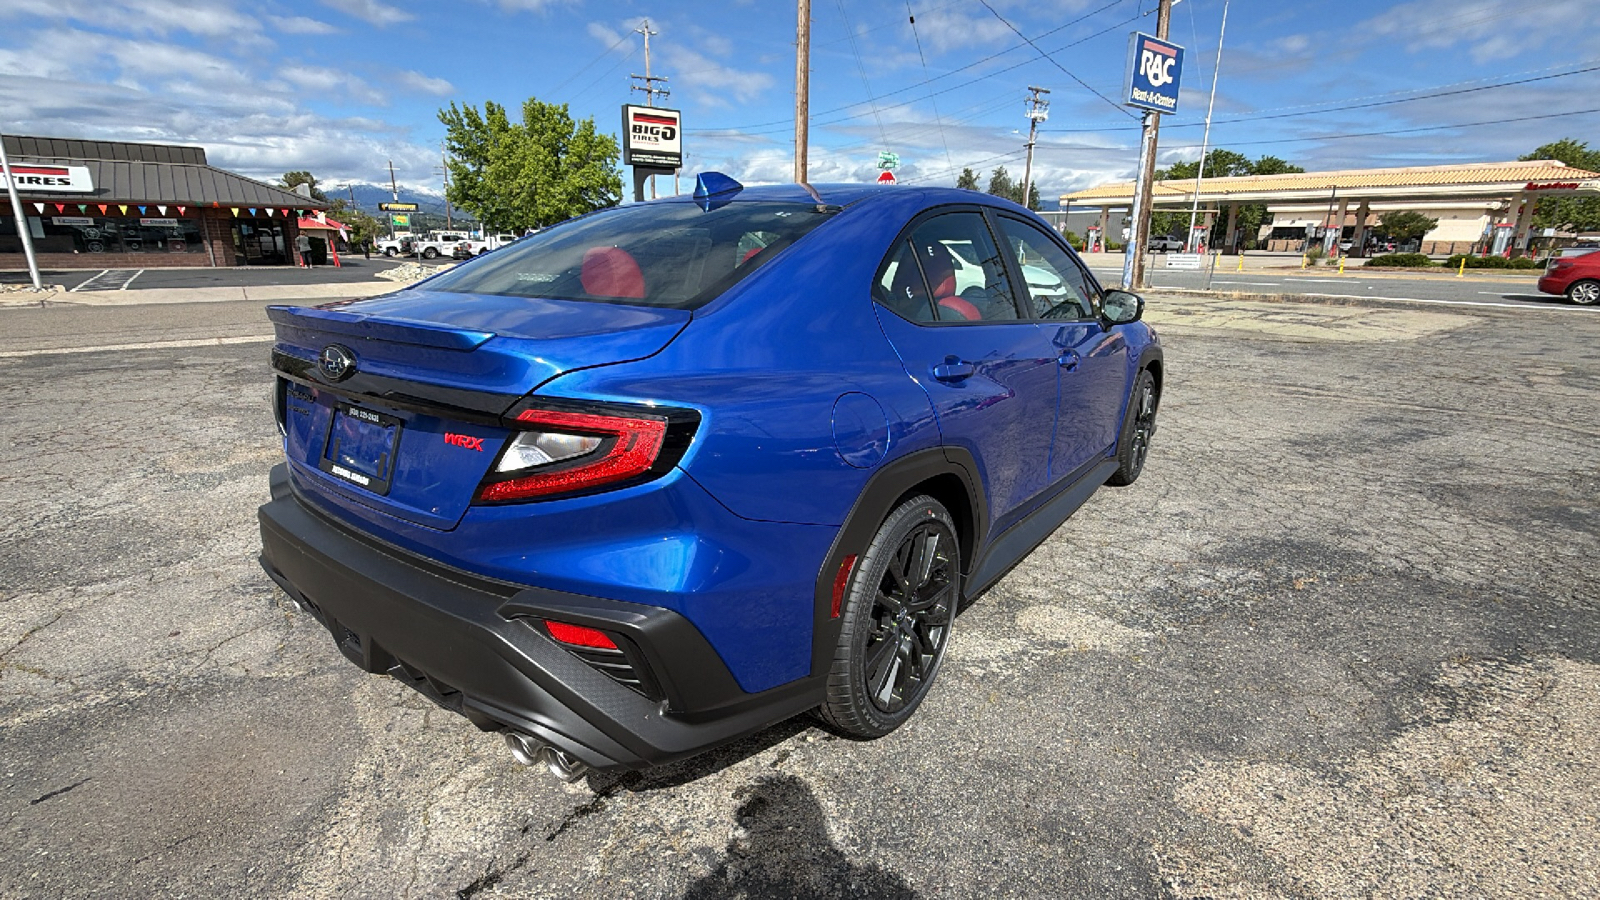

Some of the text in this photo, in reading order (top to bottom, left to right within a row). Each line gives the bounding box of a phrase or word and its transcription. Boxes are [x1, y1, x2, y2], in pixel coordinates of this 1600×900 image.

[1139, 49, 1176, 87] RAC
[632, 124, 660, 135] BIG
[632, 134, 659, 142] TIRES
[444, 432, 484, 452] WRX
